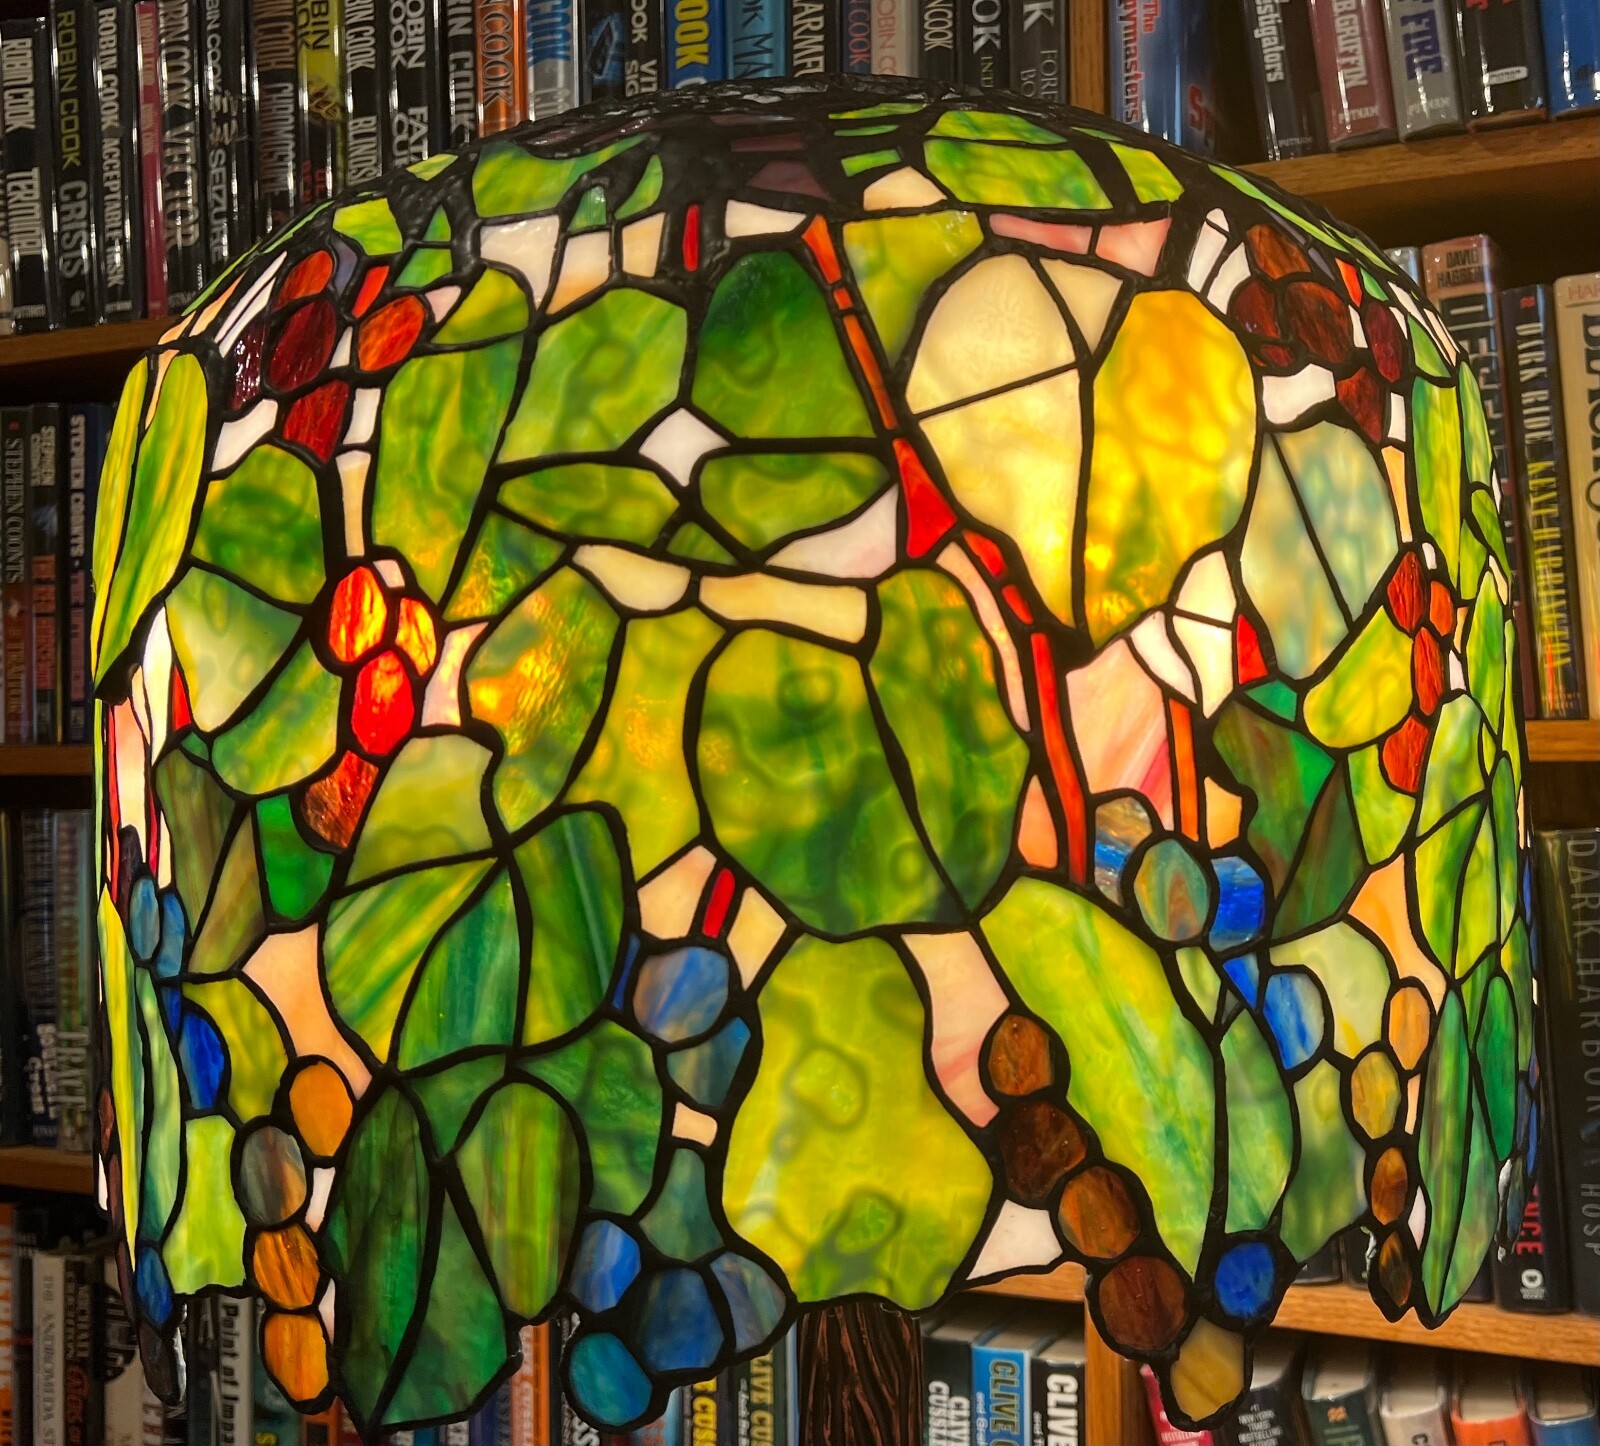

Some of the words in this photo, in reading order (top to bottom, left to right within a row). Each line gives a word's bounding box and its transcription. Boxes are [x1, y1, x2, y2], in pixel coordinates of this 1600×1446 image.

[98, 6, 118, 71] ROBIN
[345, 25, 376, 73] COOK
[389, 0, 407, 68] OOK
[793, 0, 825, 77] ARMF
[848, 9, 870, 67] COOK
[923, 8, 954, 52] COOK
[1142, 0, 1161, 32] The
[1400, 10, 1442, 80] FIRE
[2, 38, 34, 87] ROBIN
[56, 11, 78, 93] ROBIN
[161, 46, 192, 111] COOK
[207, 33, 223, 92] COOK
[480, 11, 514, 109] COOK
[1335, 14, 1369, 89] GRIFFIN
[4, 87, 36, 133] COOK
[100, 71, 121, 131] COOK
[449, 51, 475, 134] COOK
[1338, 106, 1380, 124] PUTNAM
[59, 98, 81, 170] COOK
[260, 81, 296, 197] CHROMOSOME
[6, 166, 43, 258] TERMINAL
[101, 137, 123, 241] ACCEPTABLE
[164, 122, 201, 250] VECTOR
[208, 148, 229, 264] SEIZURE
[58, 180, 89, 279] CRISIS
[1446, 249, 1478, 268] DAVID
[105, 243, 126, 288] RISK
[1515, 322, 1548, 382] DARK
[1521, 389, 1556, 446] RIDE
[5, 437, 25, 514] STEPHEN
[39, 425, 56, 486] STEPHEN
[69, 414, 86, 490] STEPHEN
[1526, 459, 1561, 518] KENT
[6, 515, 26, 584] COONTS
[69, 491, 86, 558] COONTS
[1532, 526, 1572, 669] HARRINGTON
[1566, 838, 1600, 938] DARK
[48, 1026, 91, 1113] TRACE
[1515, 1182, 1546, 1257] NCE
[221, 1304, 240, 1358] Point
[221, 1365, 240, 1386] of
[989, 1359, 1020, 1435] CLIVE
